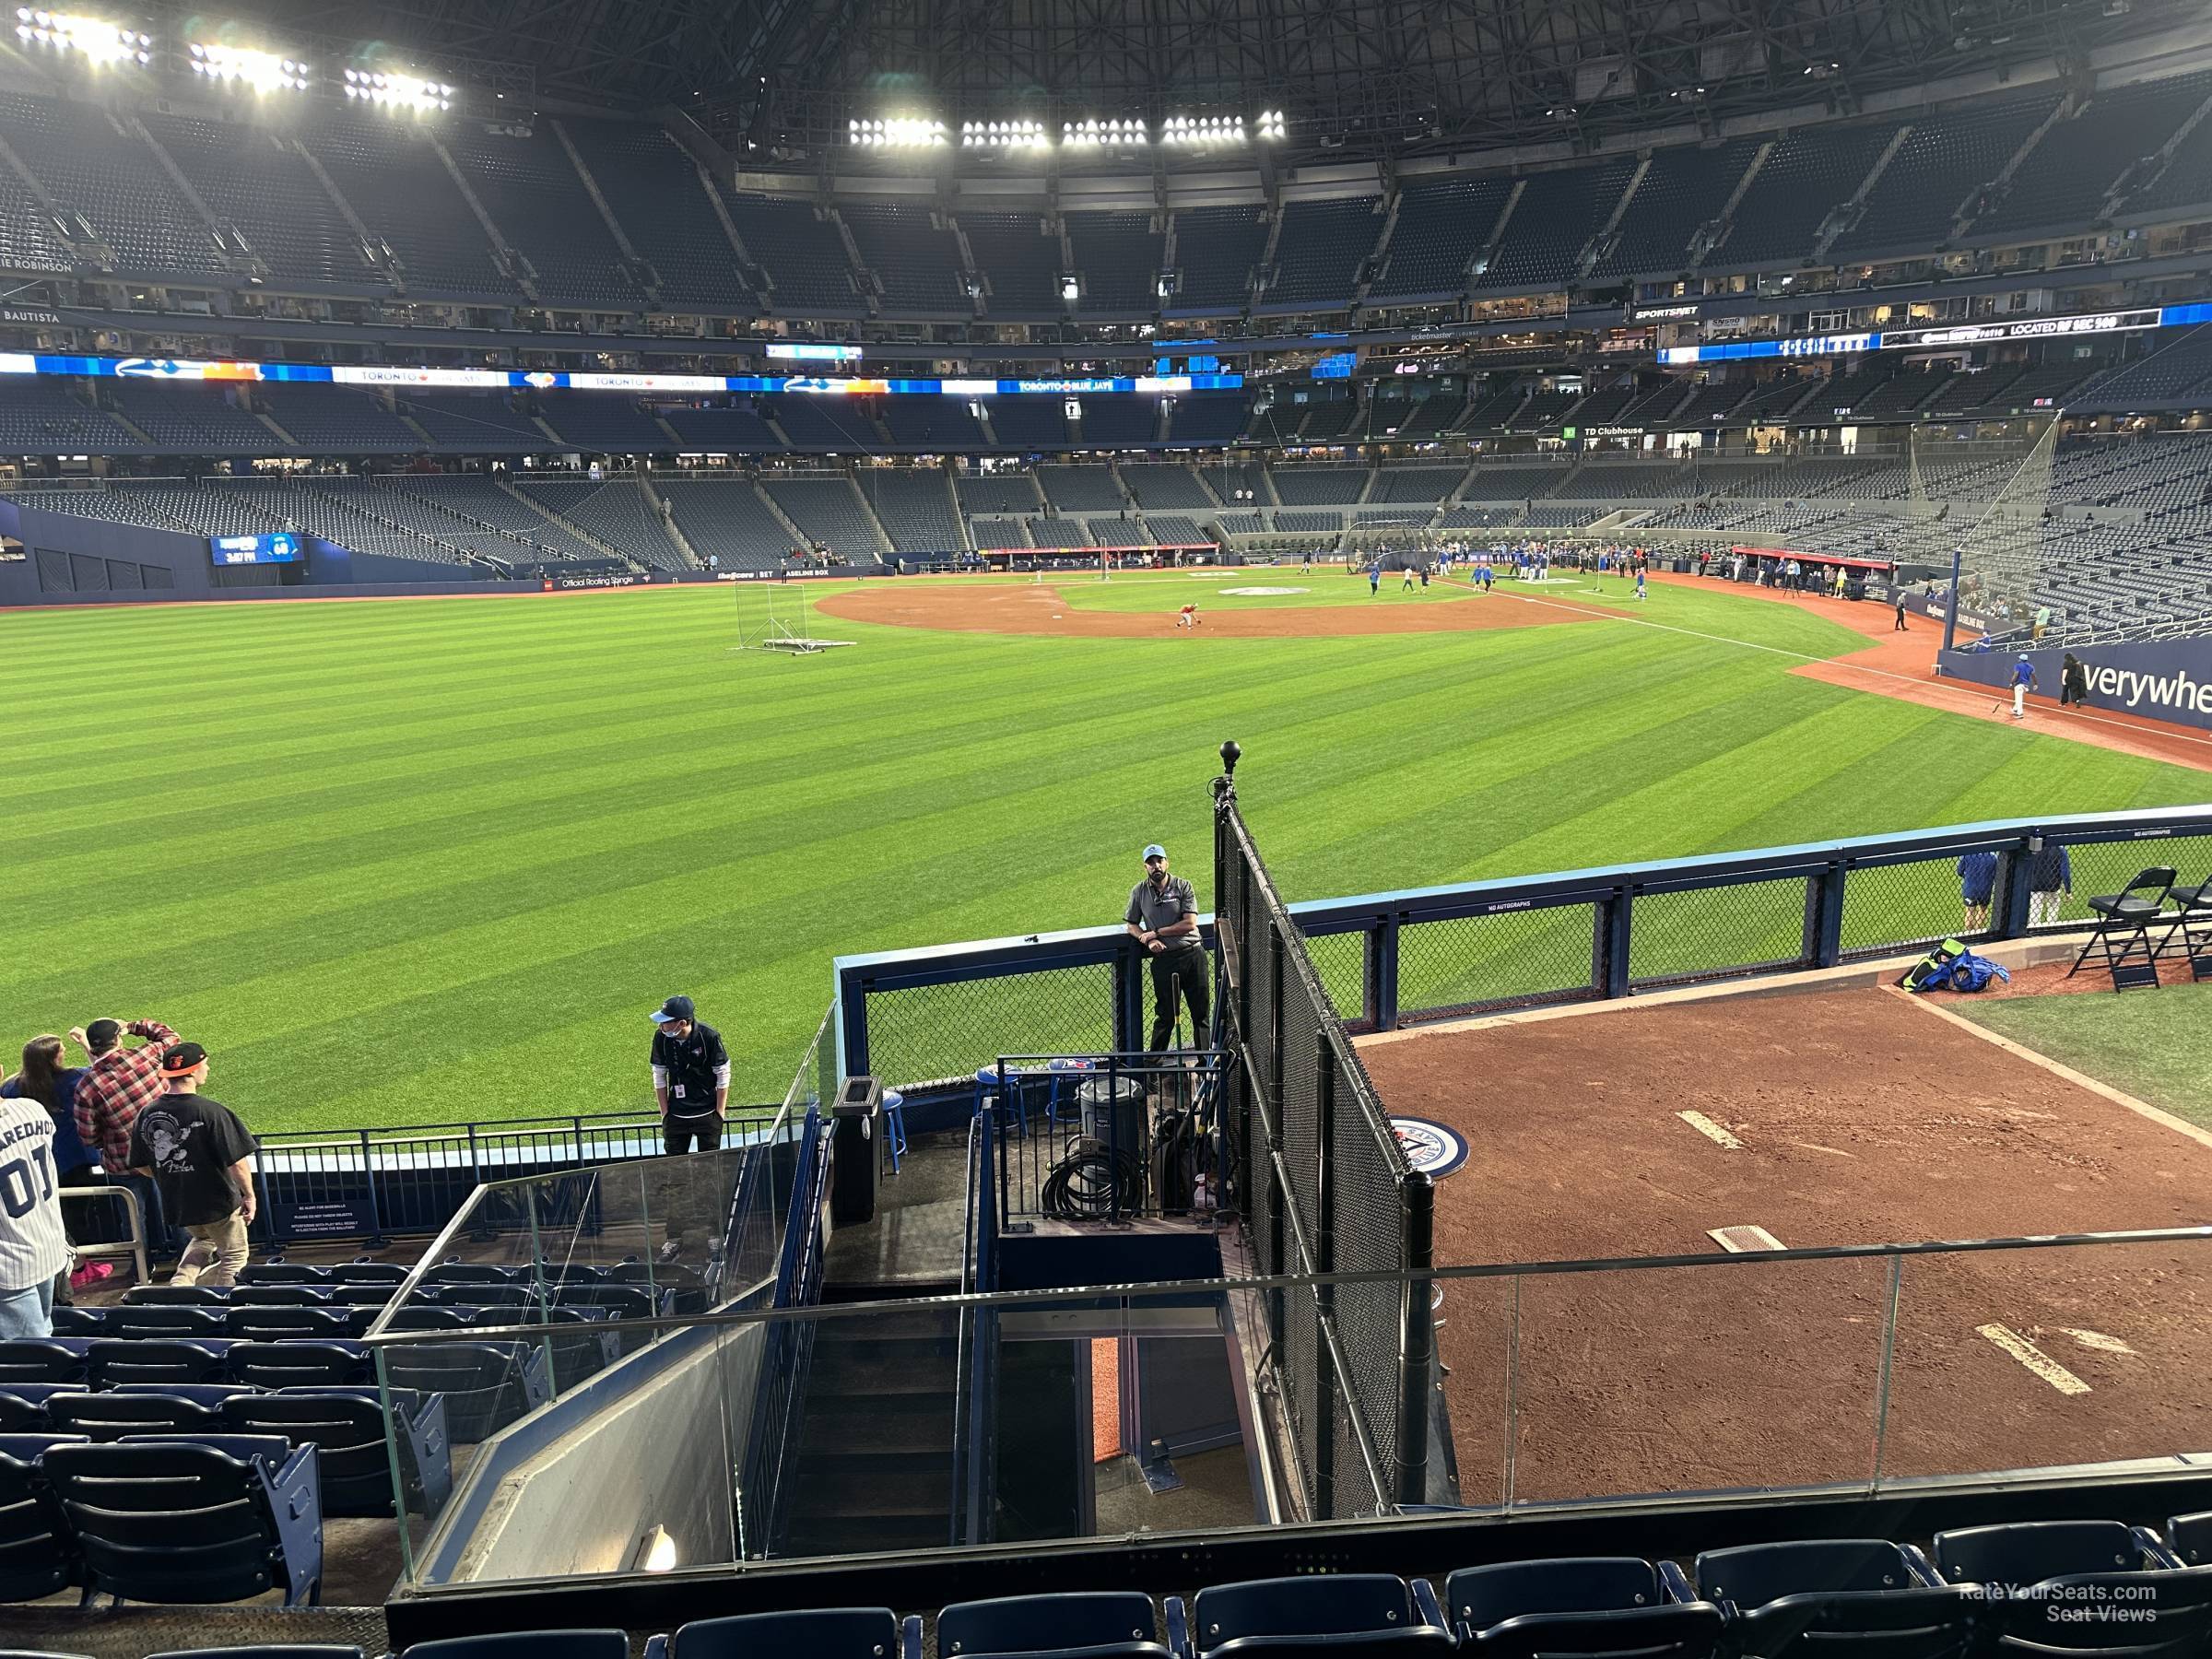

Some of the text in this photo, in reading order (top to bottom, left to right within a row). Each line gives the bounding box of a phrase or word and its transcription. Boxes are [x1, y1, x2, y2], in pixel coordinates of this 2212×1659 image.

[0, 259, 72, 273] IE ROBINSON
[4, 311, 60, 324] BAUTISTA
[1636, 306, 1698, 319] SPORTSNET
[1980, 329, 2005, 338] PATIO
[2010, 323, 2056, 335] LOCATED
[2056, 321, 2073, 332] RF
[2073, 319, 2094, 331] SEC
[1411, 332, 1452, 340] ticketmaster
[362, 371, 417, 382] TORONTO
[595, 377, 643, 386] TORONTO
[1018, 381, 1114, 391] TORONTO BLUE JAYS
[1585, 428, 1596, 436] TD
[1597, 427, 1643, 435] Clubhouse
[561, 579, 584, 588] Official
[585, 577, 609, 585] Roofing
[610, 576, 633, 584] Shingle
[2084, 665, 2212, 713] verywhe
[1497, 900, 1531, 911] AUTOGRAPHS
[162, 1159, 194, 1173] Fender
